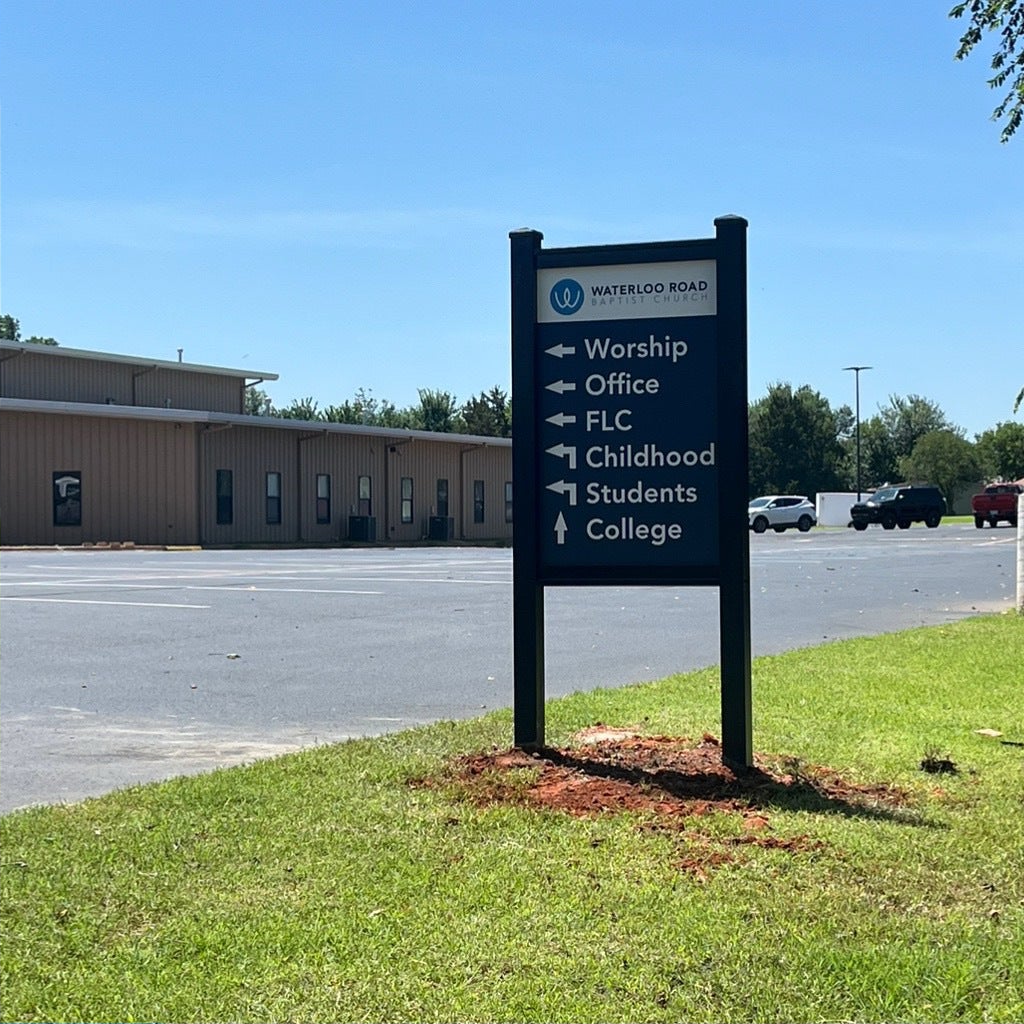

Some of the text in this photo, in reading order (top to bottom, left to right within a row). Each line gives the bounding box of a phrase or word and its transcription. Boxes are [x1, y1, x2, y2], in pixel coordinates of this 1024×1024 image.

[591, 280, 708, 296] WATERLOO ROAD
[591, 292, 708, 306] BAPTIST CHURCH
[584, 335, 688, 363] Worship
[585, 372, 660, 396] Office
[586, 409, 633, 432] FLC
[585, 443, 716, 468] Childhood
[586, 480, 697, 504] Students
[586, 518, 682, 546] College
